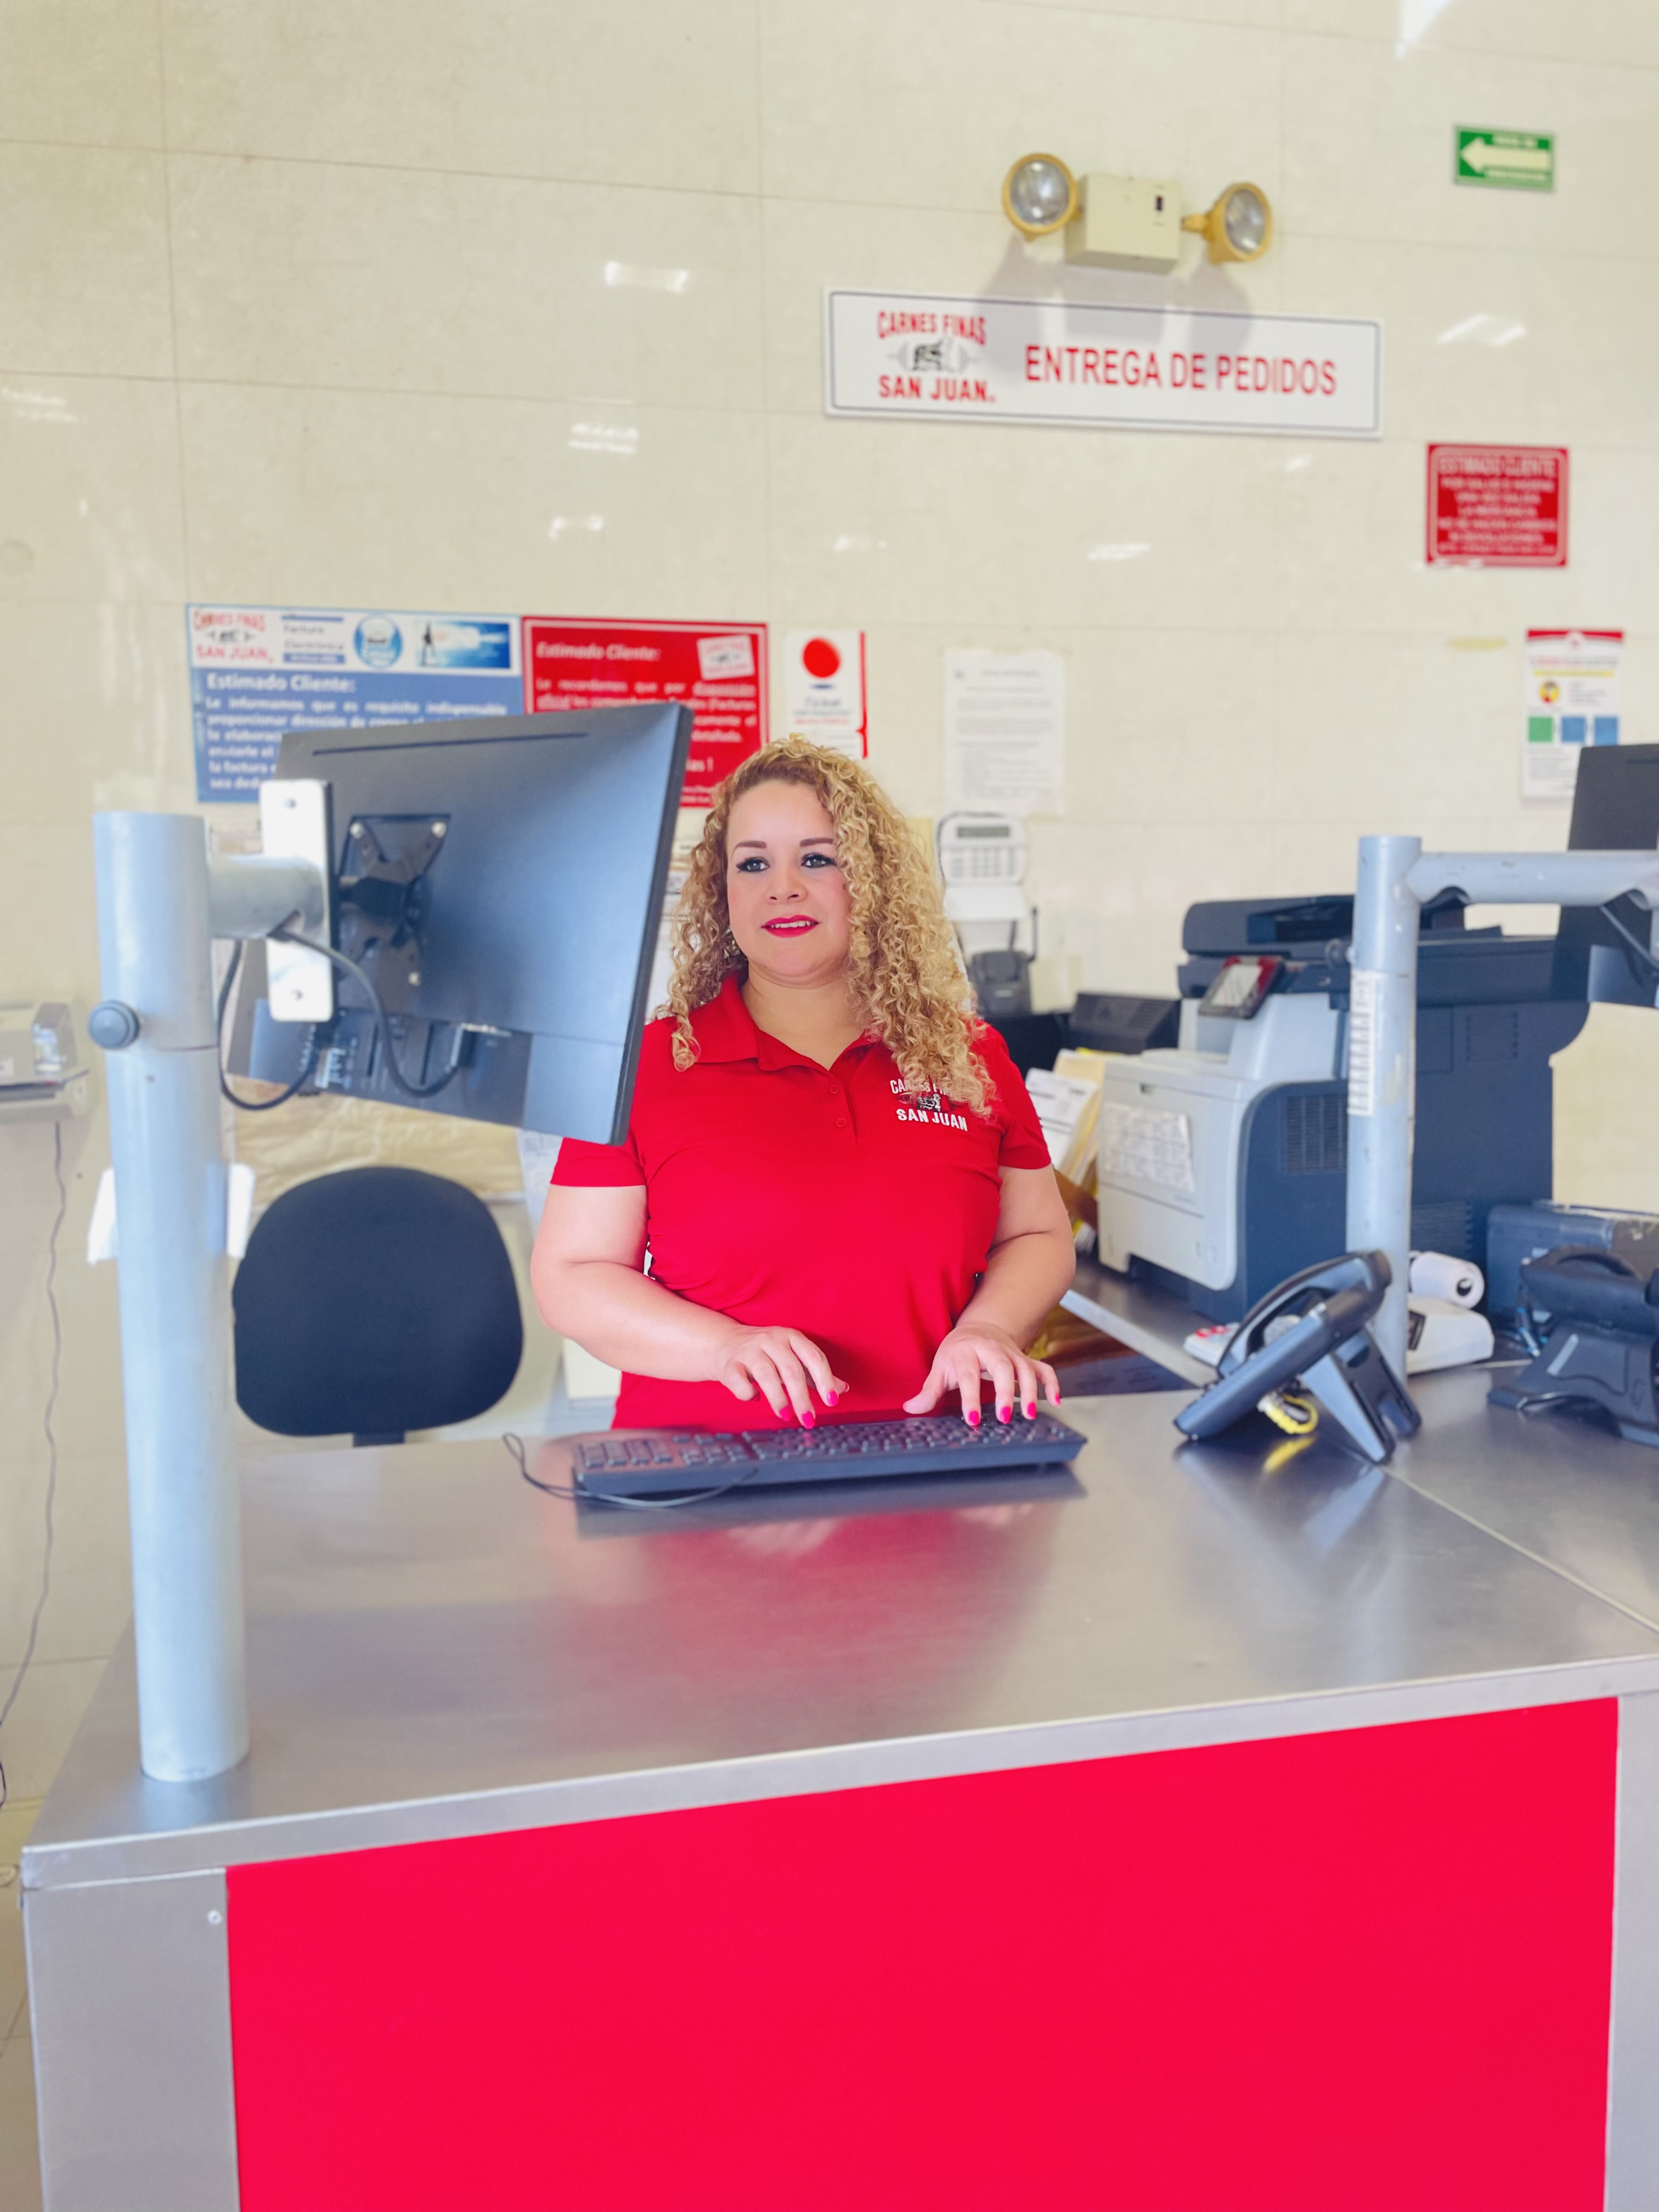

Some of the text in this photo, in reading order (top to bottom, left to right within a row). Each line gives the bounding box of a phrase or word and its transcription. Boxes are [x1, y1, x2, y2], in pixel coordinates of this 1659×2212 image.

[878, 311, 985, 347] CARNES FINAS
[1026, 345, 1338, 395] ENTREGA DE PEDIDOS
[878, 375, 922, 399] SAN
[284, 624, 324, 635] Factura
[196, 645, 225, 658] SAN
[536, 641, 661, 662] Estimado Cliente:
[207, 673, 356, 693] Estimado Cliente:
[558, 678, 628, 693] recordamos
[634, 681, 658, 695] que
[205, 696, 507, 716] Le informamos que es requisito indispensable
[206, 714, 287, 727] proporcionar
[207, 730, 220, 741] la
[209, 761, 222, 774] la
[223, 761, 268, 774] factura
[210, 778, 232, 789] sea
[890, 1079, 931, 1094] CAS
[896, 1108, 968, 1132] SAN JUAN
